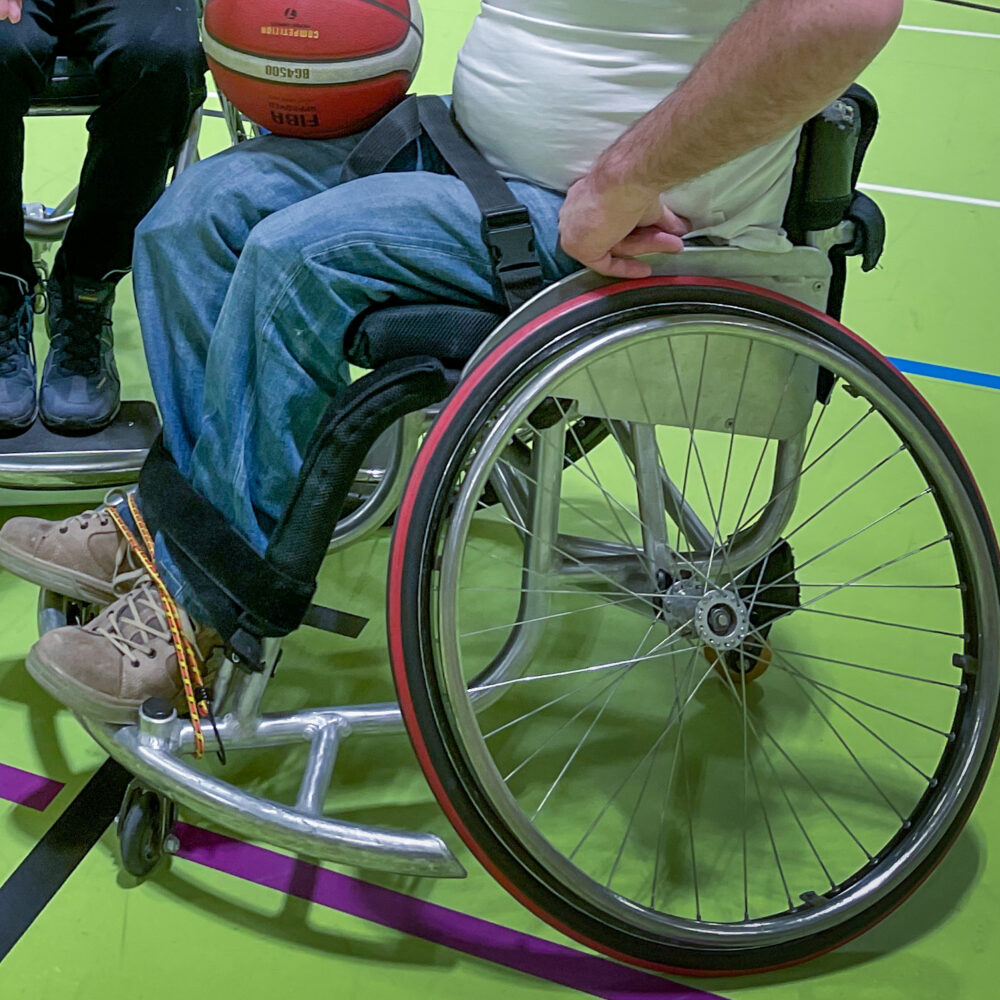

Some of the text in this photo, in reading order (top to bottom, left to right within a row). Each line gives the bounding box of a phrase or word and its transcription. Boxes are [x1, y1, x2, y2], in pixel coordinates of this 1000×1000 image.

[260, 26, 320, 39] COMPETITION
[265, 65, 310, 79] BG4500
[270, 110, 320, 128] FIBA
